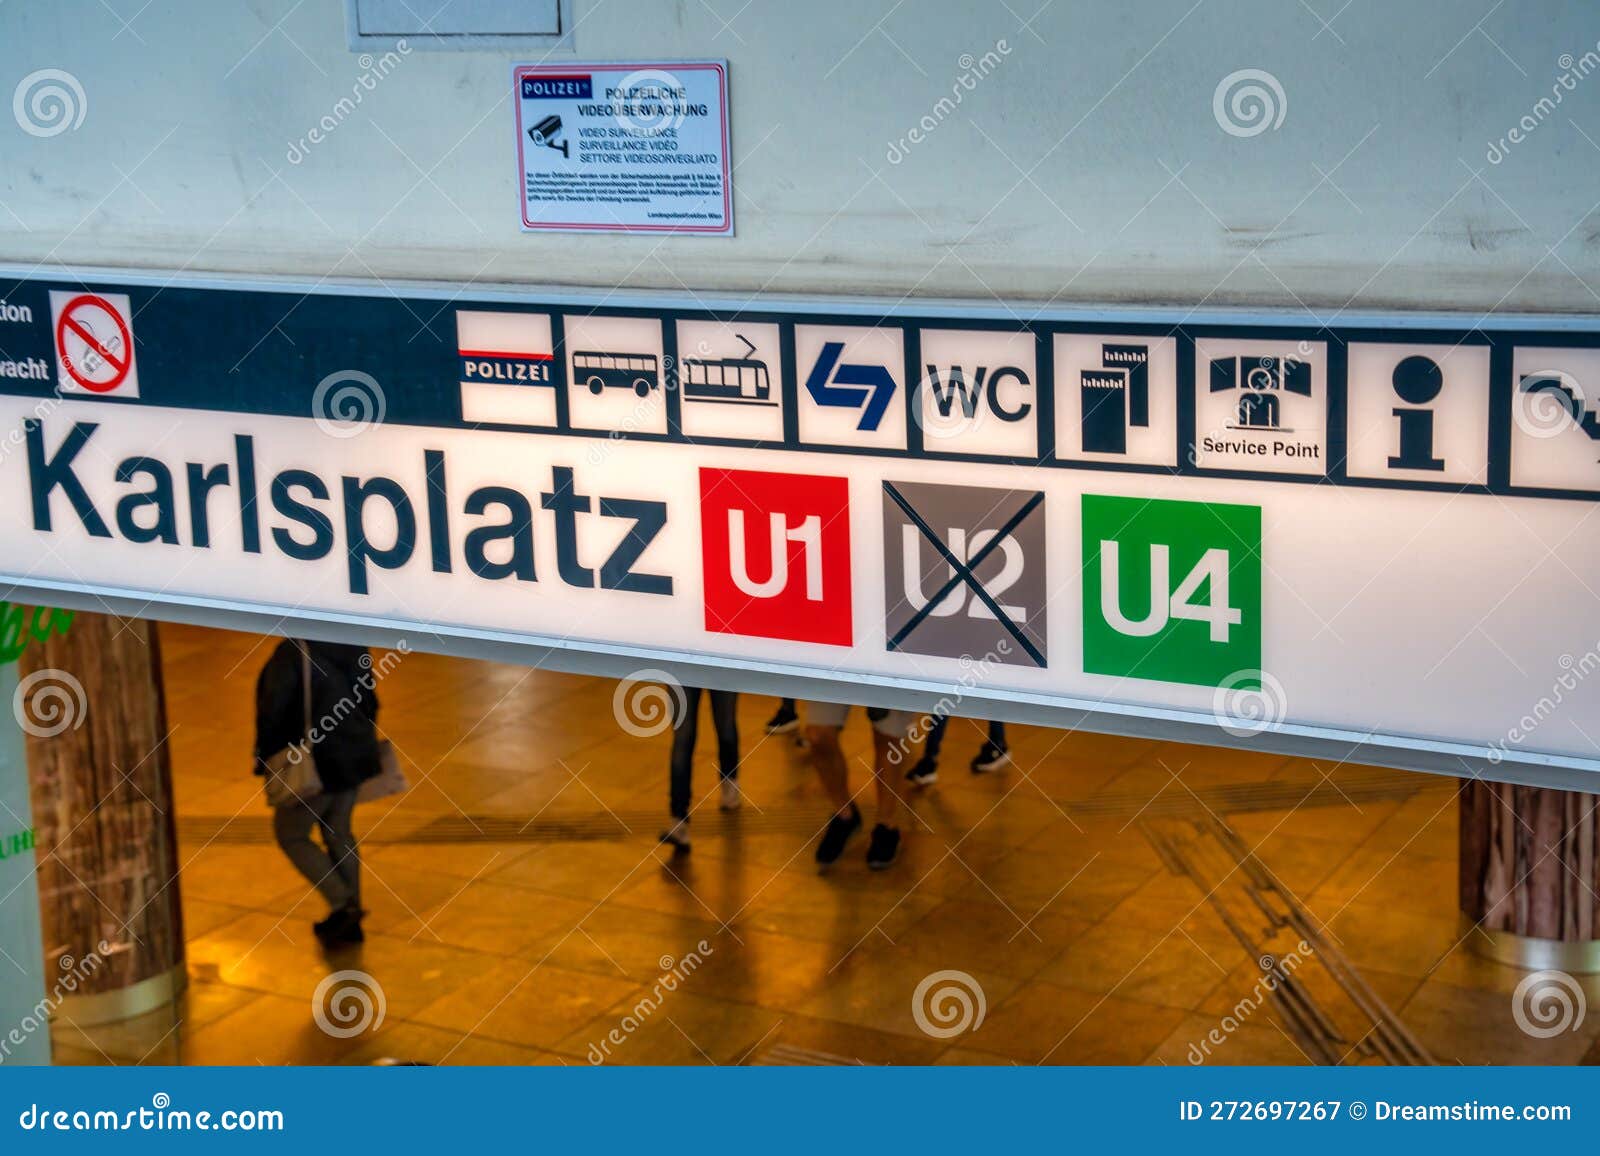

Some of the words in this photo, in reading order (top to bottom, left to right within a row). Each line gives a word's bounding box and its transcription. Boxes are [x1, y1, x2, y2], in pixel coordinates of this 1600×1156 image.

[524, 82, 580, 95] POLIZEI
[605, 87, 686, 99] POLIZEILICHE
[577, 102, 708, 116] VIDEOÜBERWACHUNG
[578, 128, 607, 137] VIDEO
[608, 127, 678, 138] SURVEILLANCE
[580, 140, 648, 151] SURVEILLANCE
[580, 153, 622, 163] SETTORE
[624, 153, 717, 164] VIDEOSORVEGLIATO
[0, 299, 32, 323] ion
[464, 361, 549, 381] POLIZEI
[926, 364, 1031, 422] WC
[1203, 437, 1267, 455] Service
[1273, 441, 1320, 458] Point
[22, 417, 674, 596] Karlsplatz
[727, 508, 824, 602] U1
[902, 523, 1027, 623] U2
[1100, 539, 1242, 643] U4
